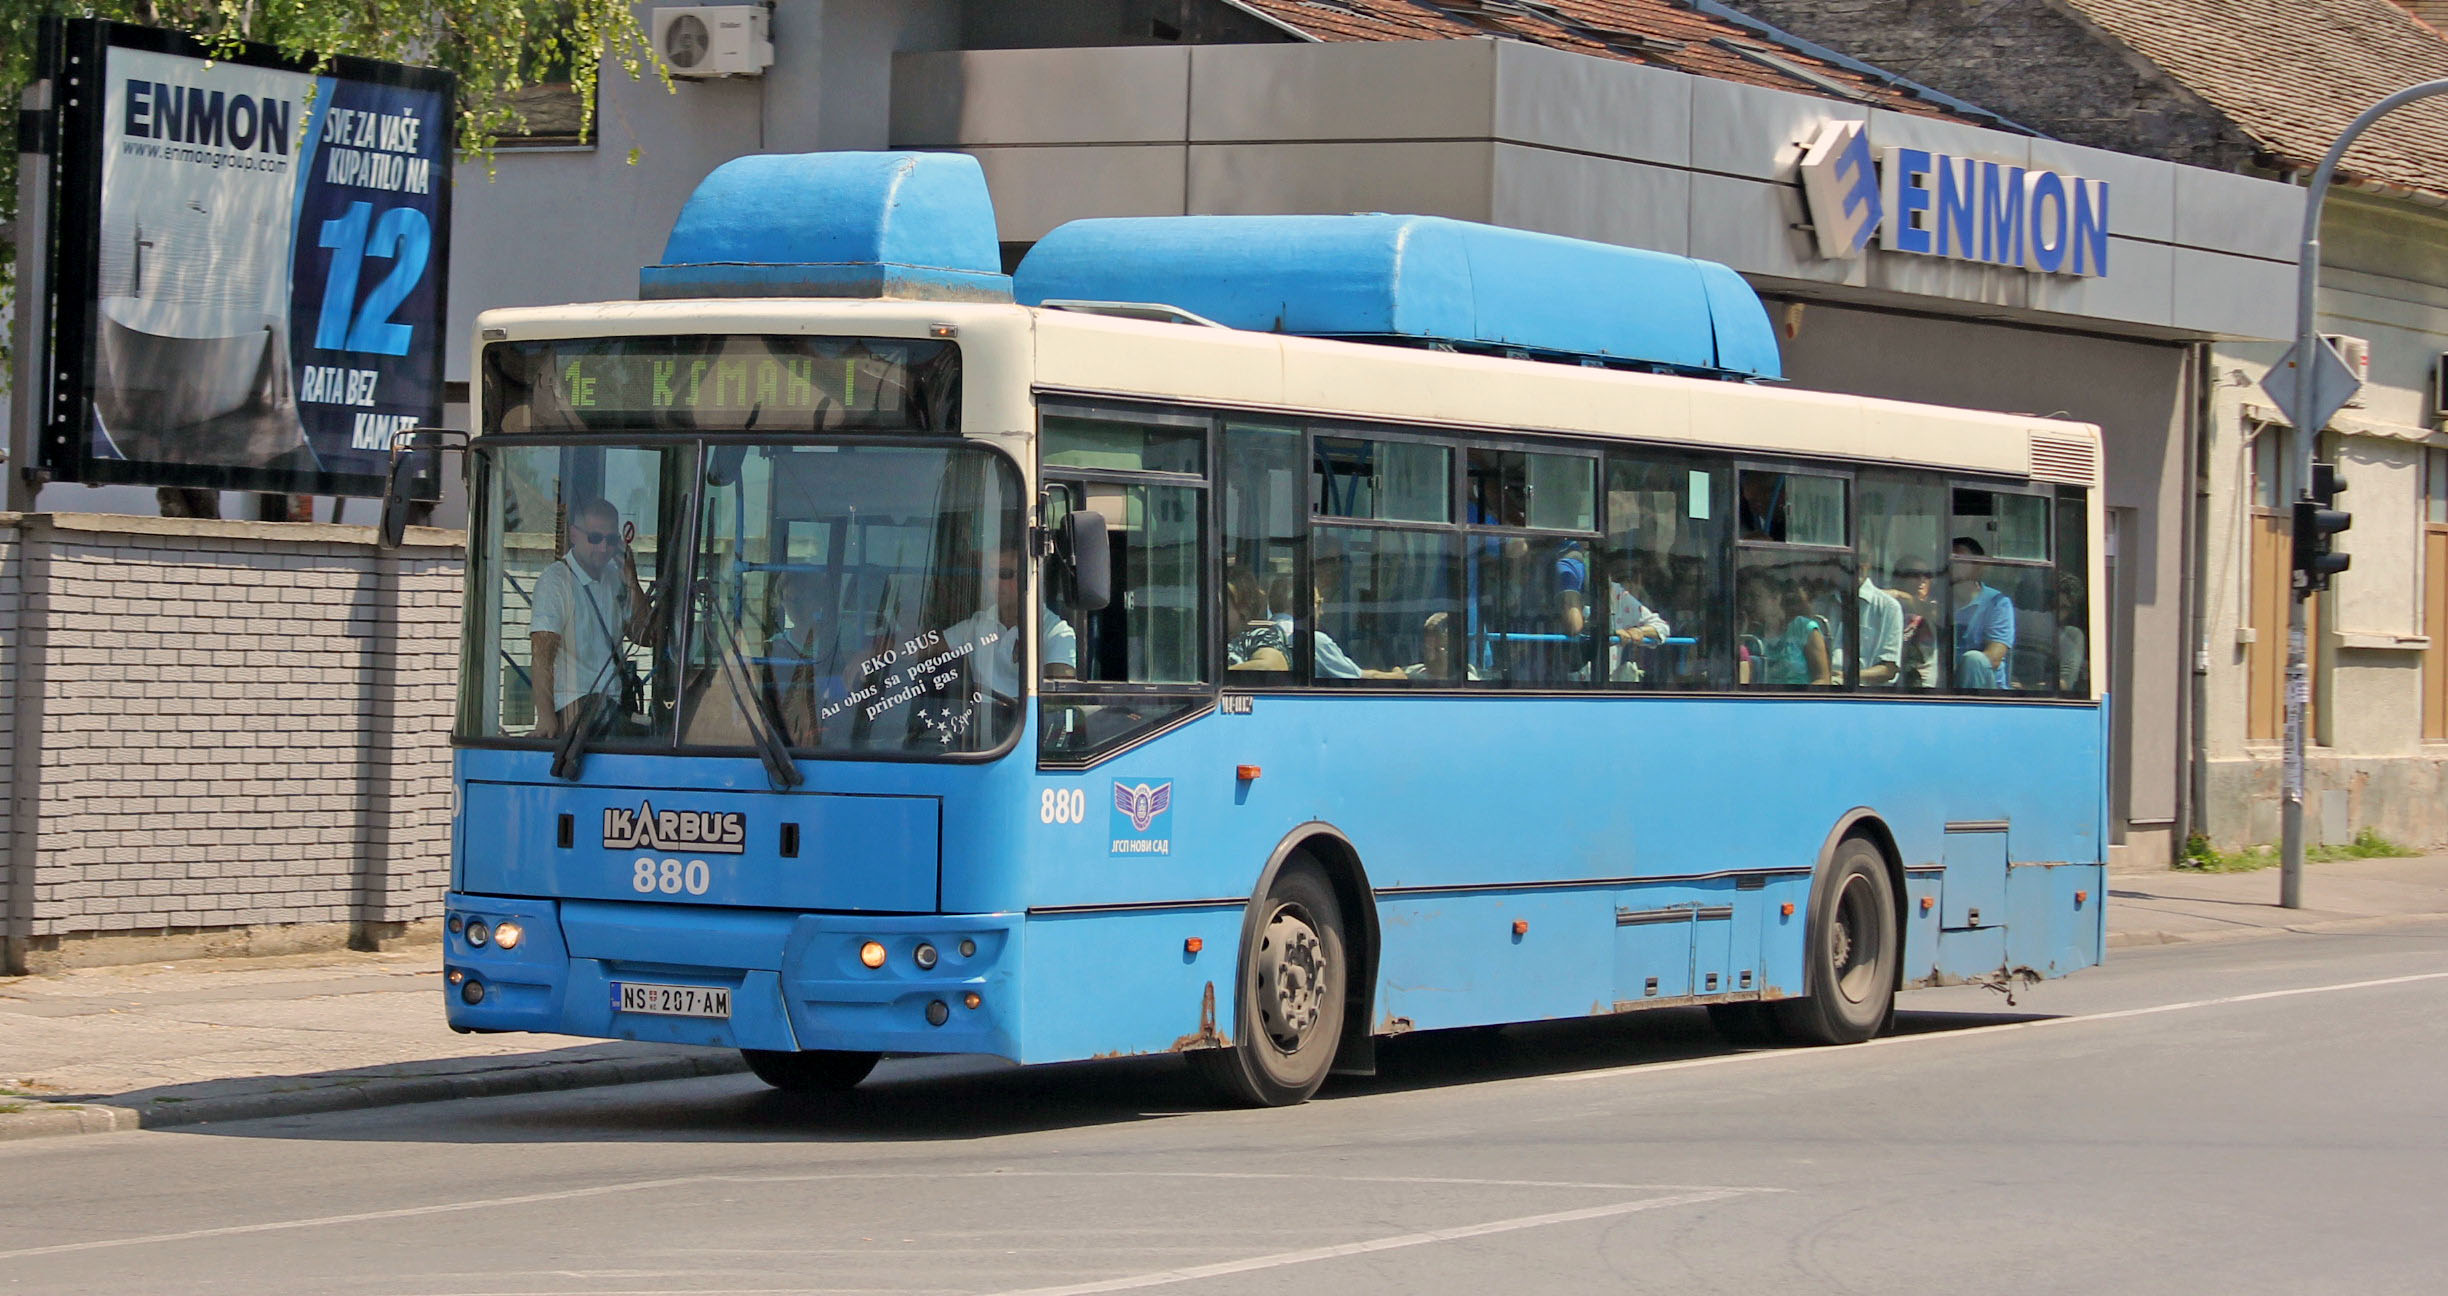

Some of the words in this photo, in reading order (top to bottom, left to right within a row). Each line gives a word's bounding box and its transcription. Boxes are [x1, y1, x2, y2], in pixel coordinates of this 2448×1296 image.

[124, 78, 291, 156] ENMON
[323, 106, 356, 146] SVE
[353, 110, 377, 149] ZA
[380, 107, 421, 154] VAŠE
[122, 141, 289, 174] www.enmongroup.com
[326, 147, 405, 192] KUPATILO
[404, 157, 430, 195] NA
[1893, 147, 2109, 278] ENMON
[313, 200, 432, 356] 12
[301, 364, 344, 404] RATA
[345, 368, 379, 407] BEZ
[861, 649, 898, 677] EKO
[884, 674, 901, 689] sa
[866, 680, 927, 721] prirodni
[932, 668, 959, 691] gas
[603, 800, 745, 852] IKARBUS
[1041, 788, 1085, 824] 880
[632, 857, 710, 896] 880
[624, 987, 646, 1009] NS
